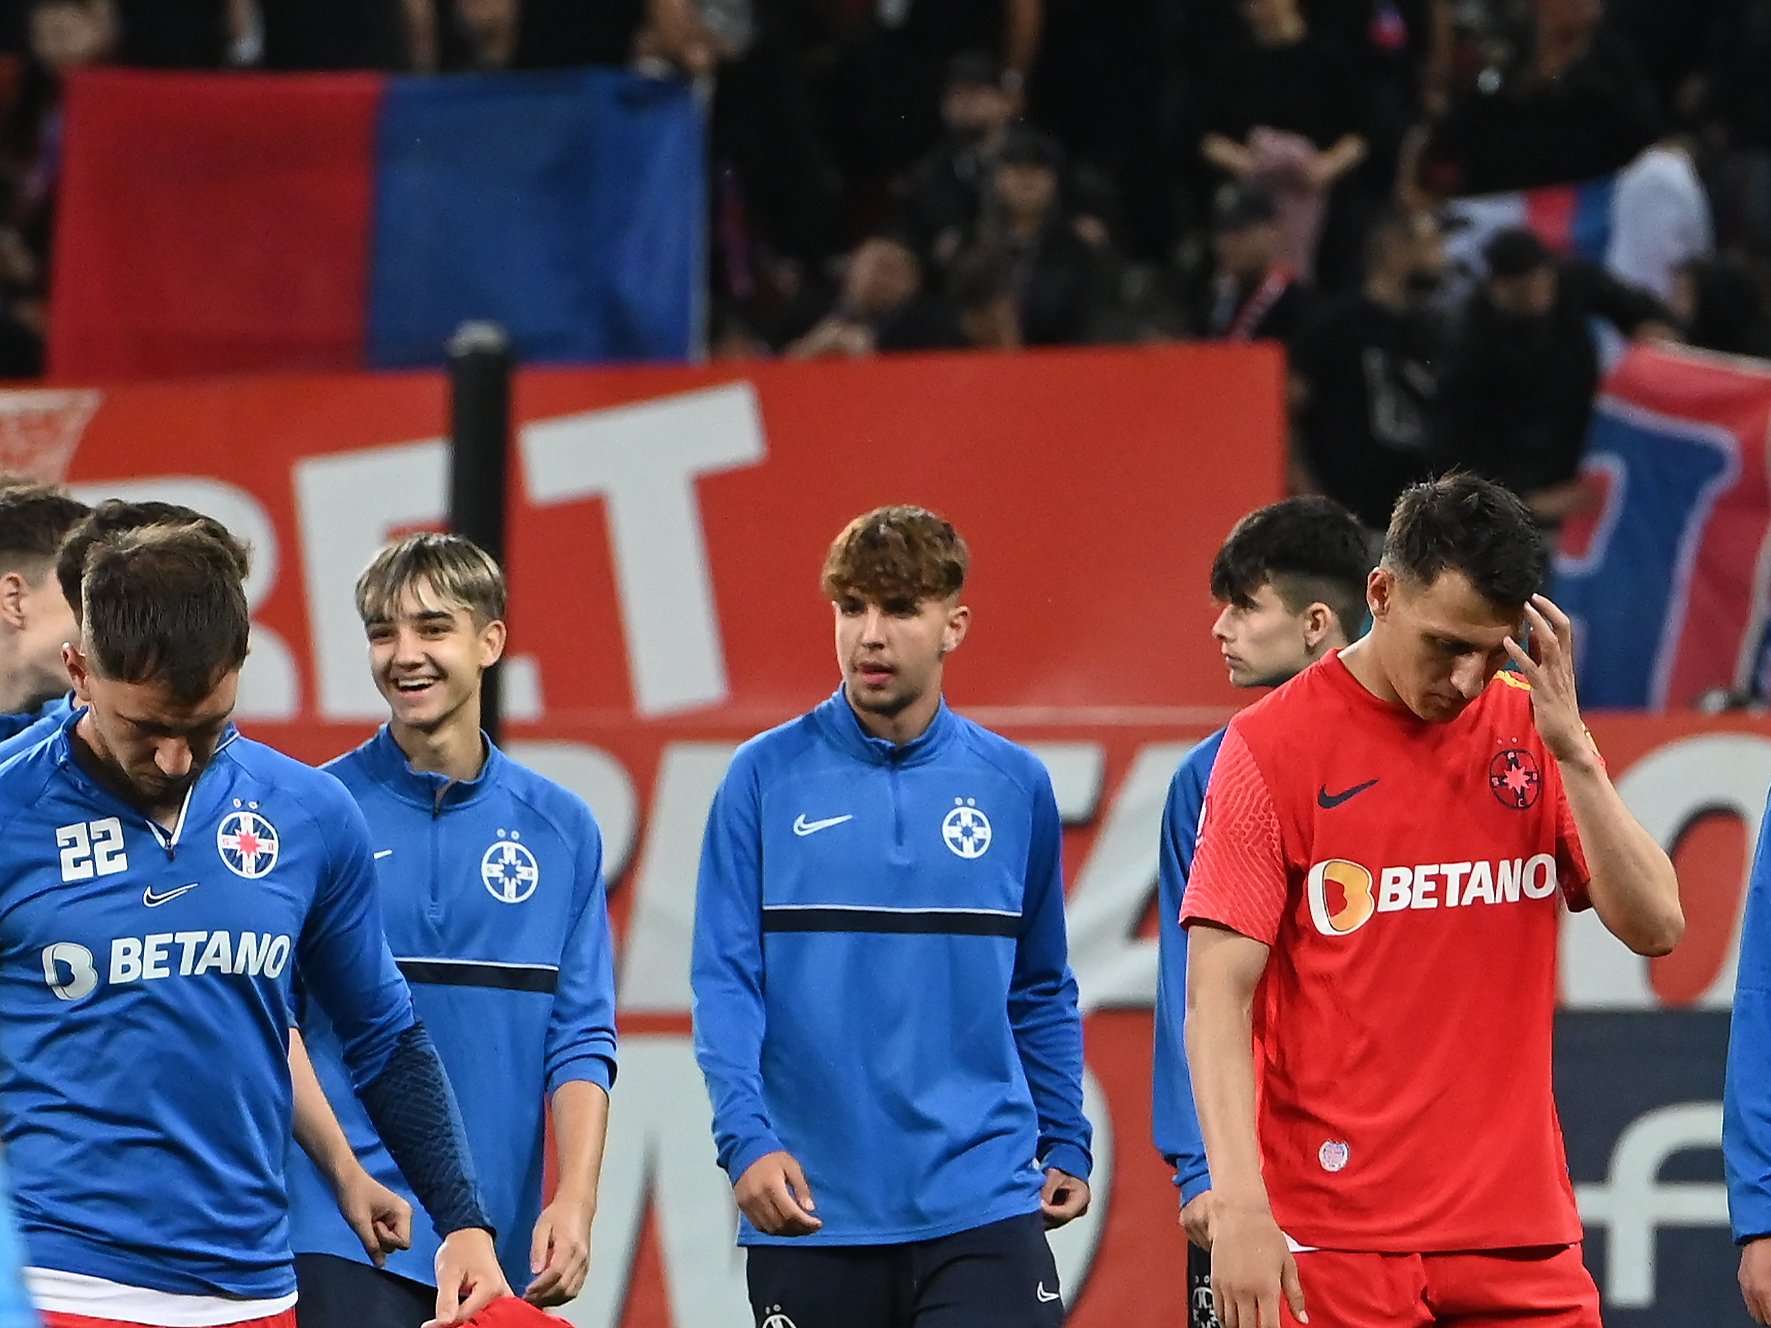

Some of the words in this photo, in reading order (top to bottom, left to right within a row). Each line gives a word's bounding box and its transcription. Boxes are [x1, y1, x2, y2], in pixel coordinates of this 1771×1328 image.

[56, 817, 128, 882] 22
[1377, 853, 1557, 913] BETANO
[109, 930, 291, 985] BETANO
